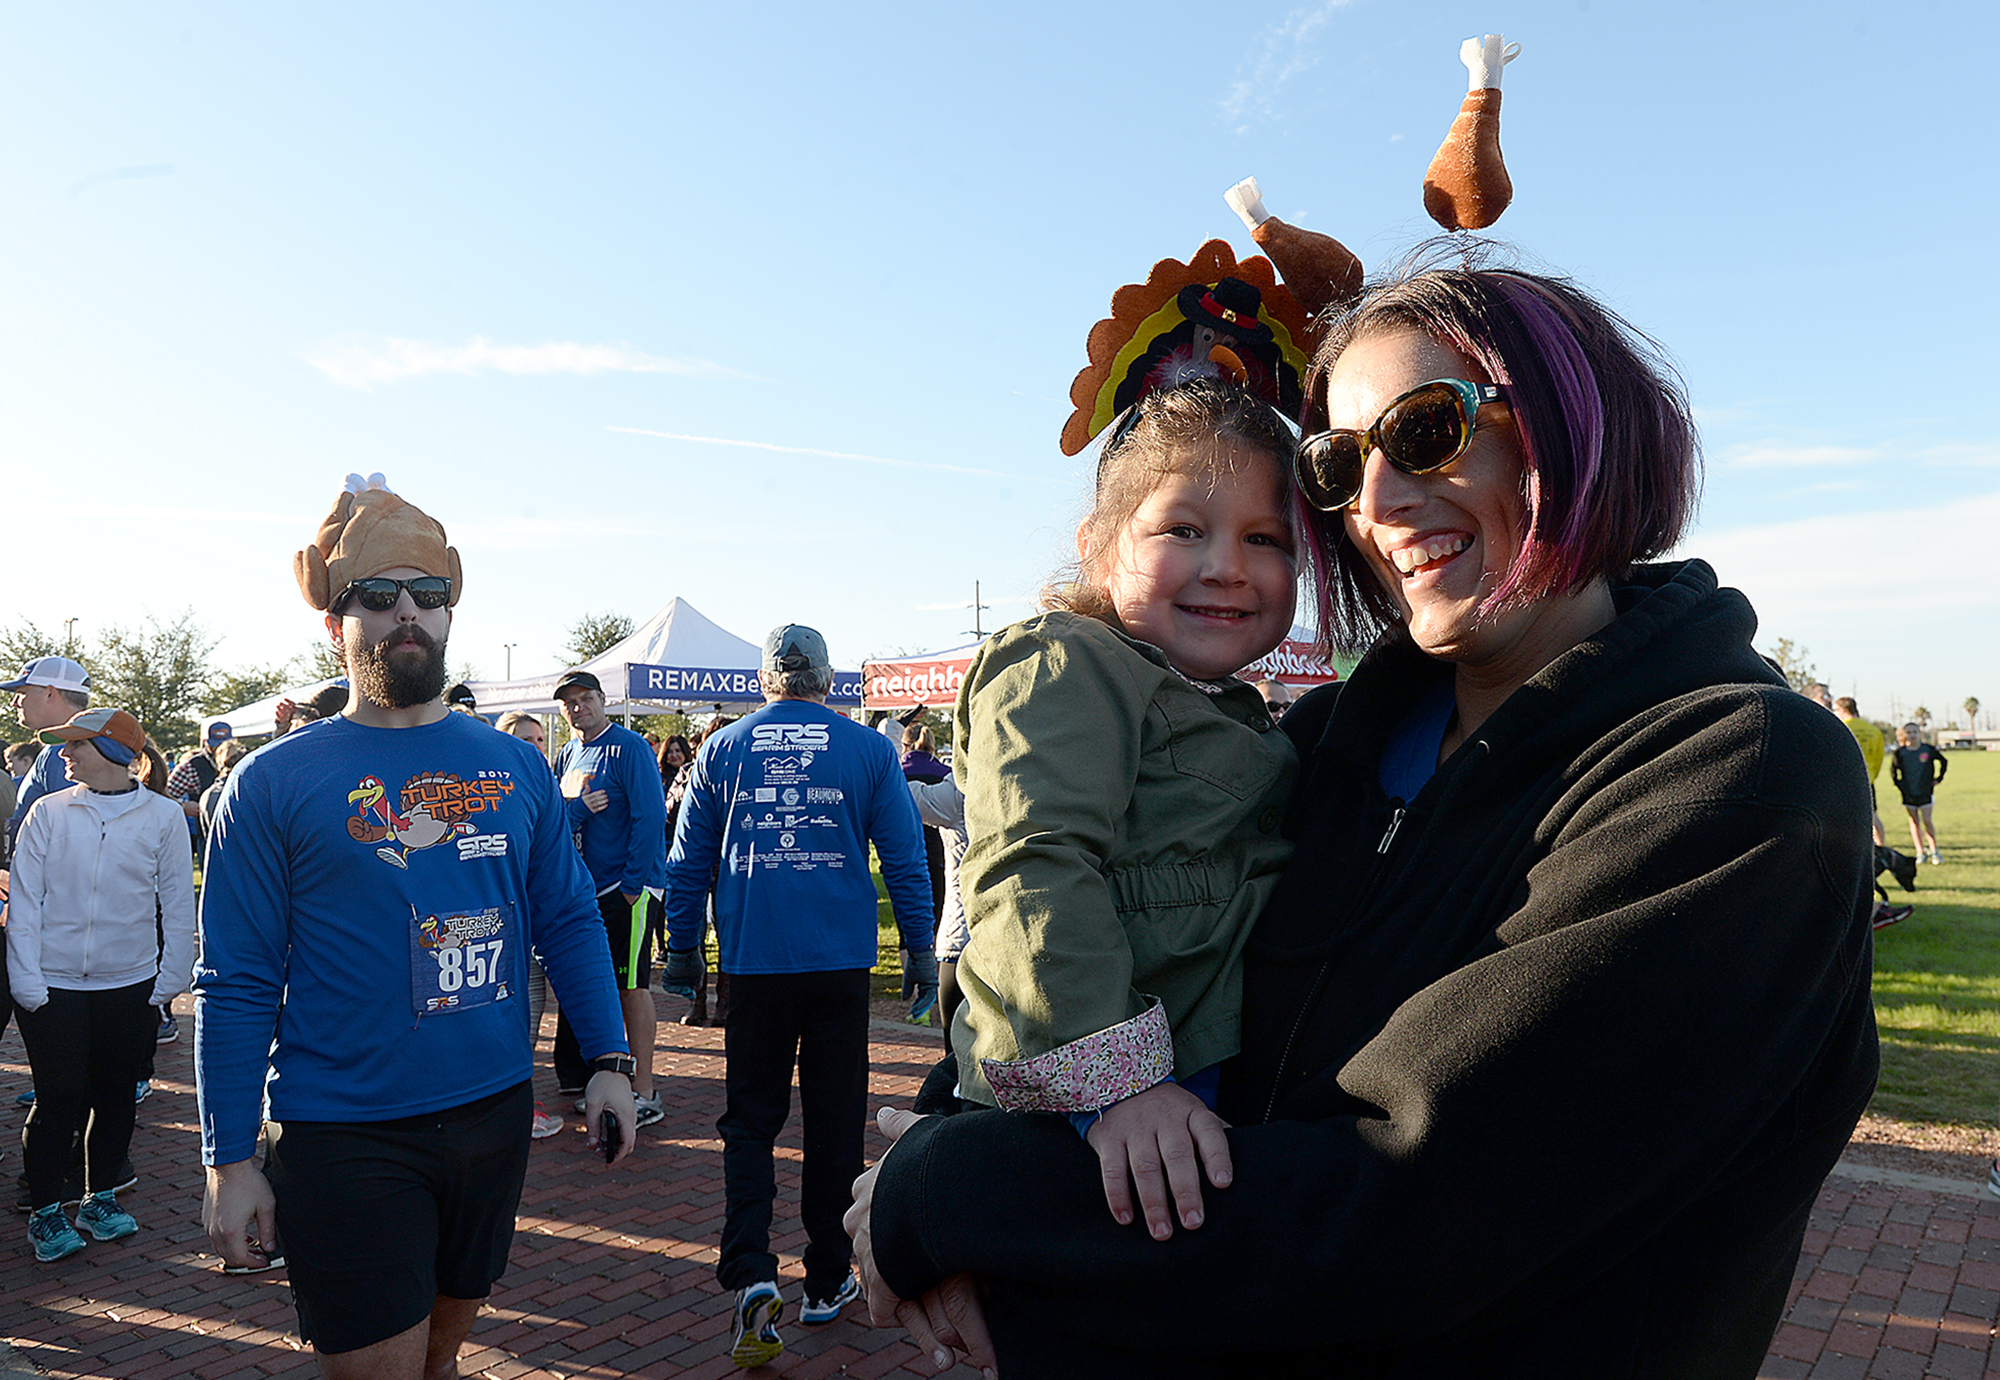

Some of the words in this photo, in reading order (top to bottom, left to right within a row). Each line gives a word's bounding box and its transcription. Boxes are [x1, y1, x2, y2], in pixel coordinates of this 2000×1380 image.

[504, 687, 527, 701] one
[528, 681, 553, 698] sells
[871, 665, 963, 702] neighb
[478, 771, 510, 779] 2017
[401, 780, 515, 804] TURKEY
[423, 796, 502, 819] TROT
[445, 913, 499, 931] TURKEY
[455, 928, 490, 940] TROT
[438, 939, 503, 992] 857
